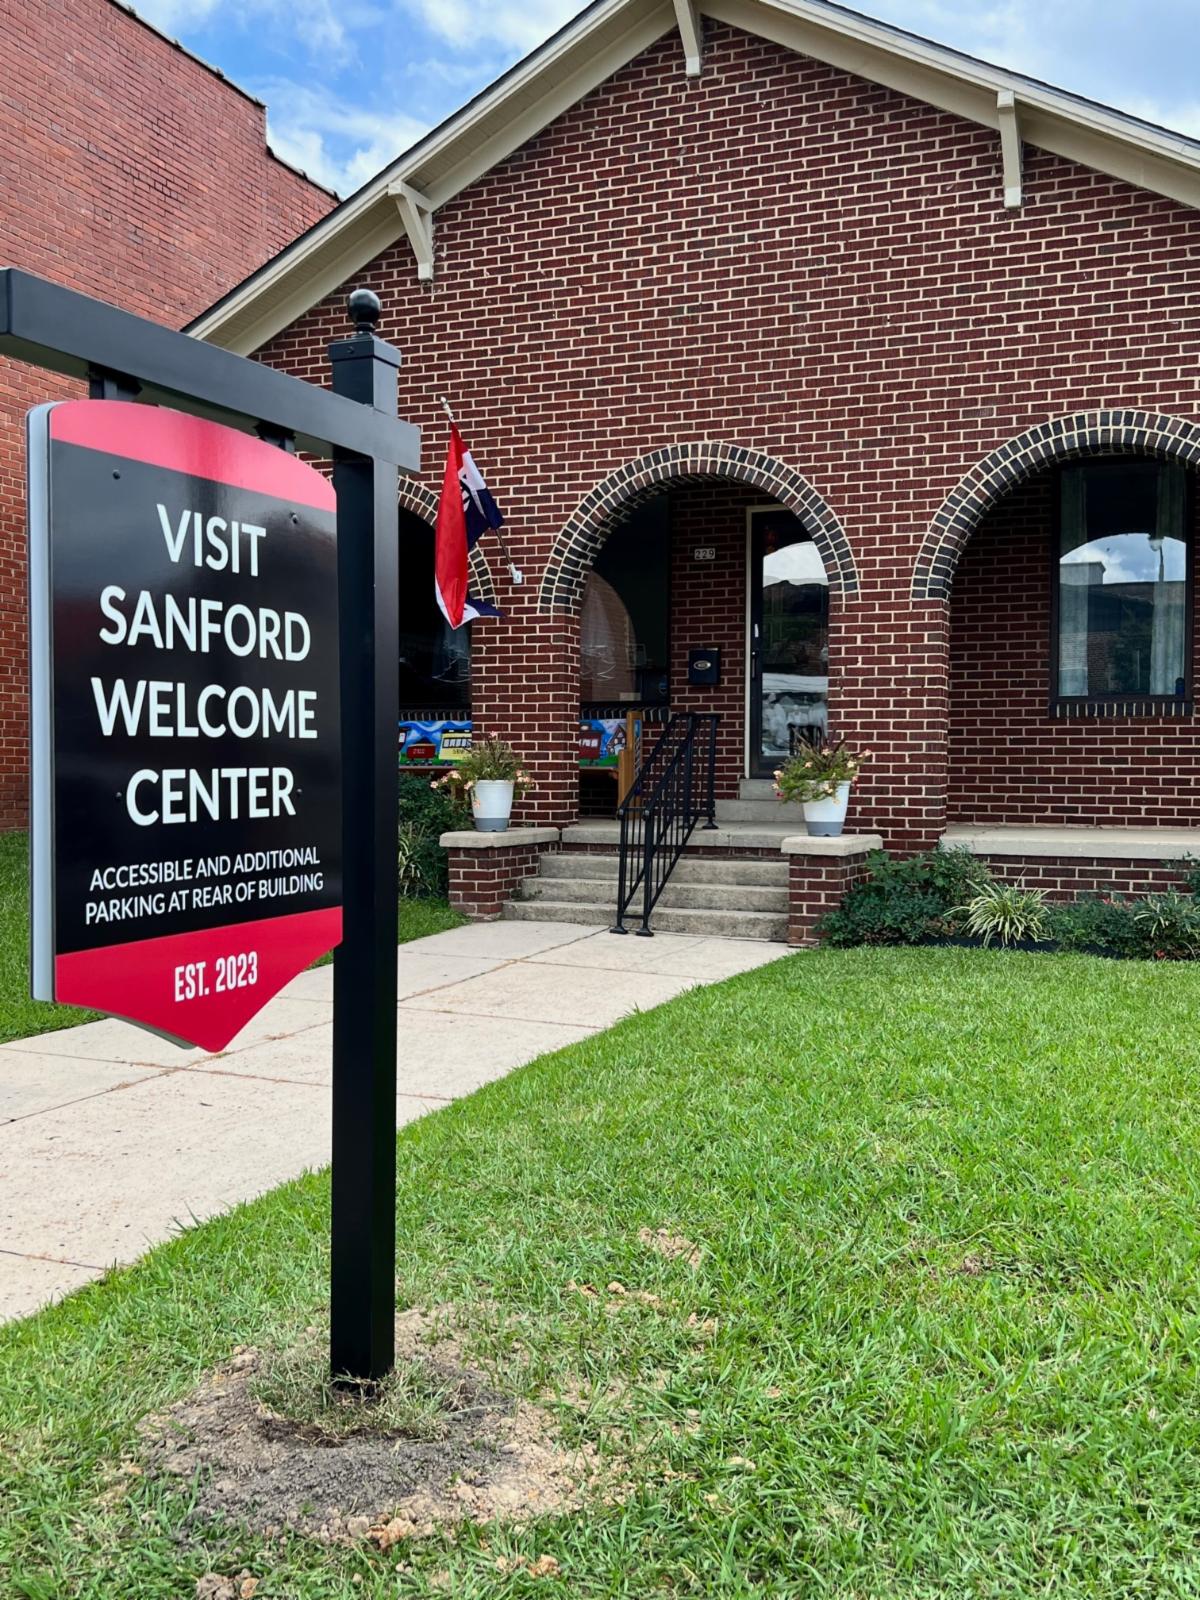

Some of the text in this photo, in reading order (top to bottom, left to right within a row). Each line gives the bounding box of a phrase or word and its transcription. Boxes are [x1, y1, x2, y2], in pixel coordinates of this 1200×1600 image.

[157, 503, 266, 577] VISIT
[695, 549, 715, 559] 229
[100, 585, 311, 662] SANFORD
[91, 677, 318, 738] WELCOME
[126, 768, 297, 825] CENTER
[90, 847, 320, 891] ACCESSIBLE AND ADDITIONAL
[86, 873, 324, 924] PARKING AT REAR OF BUILDING
[175, 952, 258, 1001] EST. 2023
